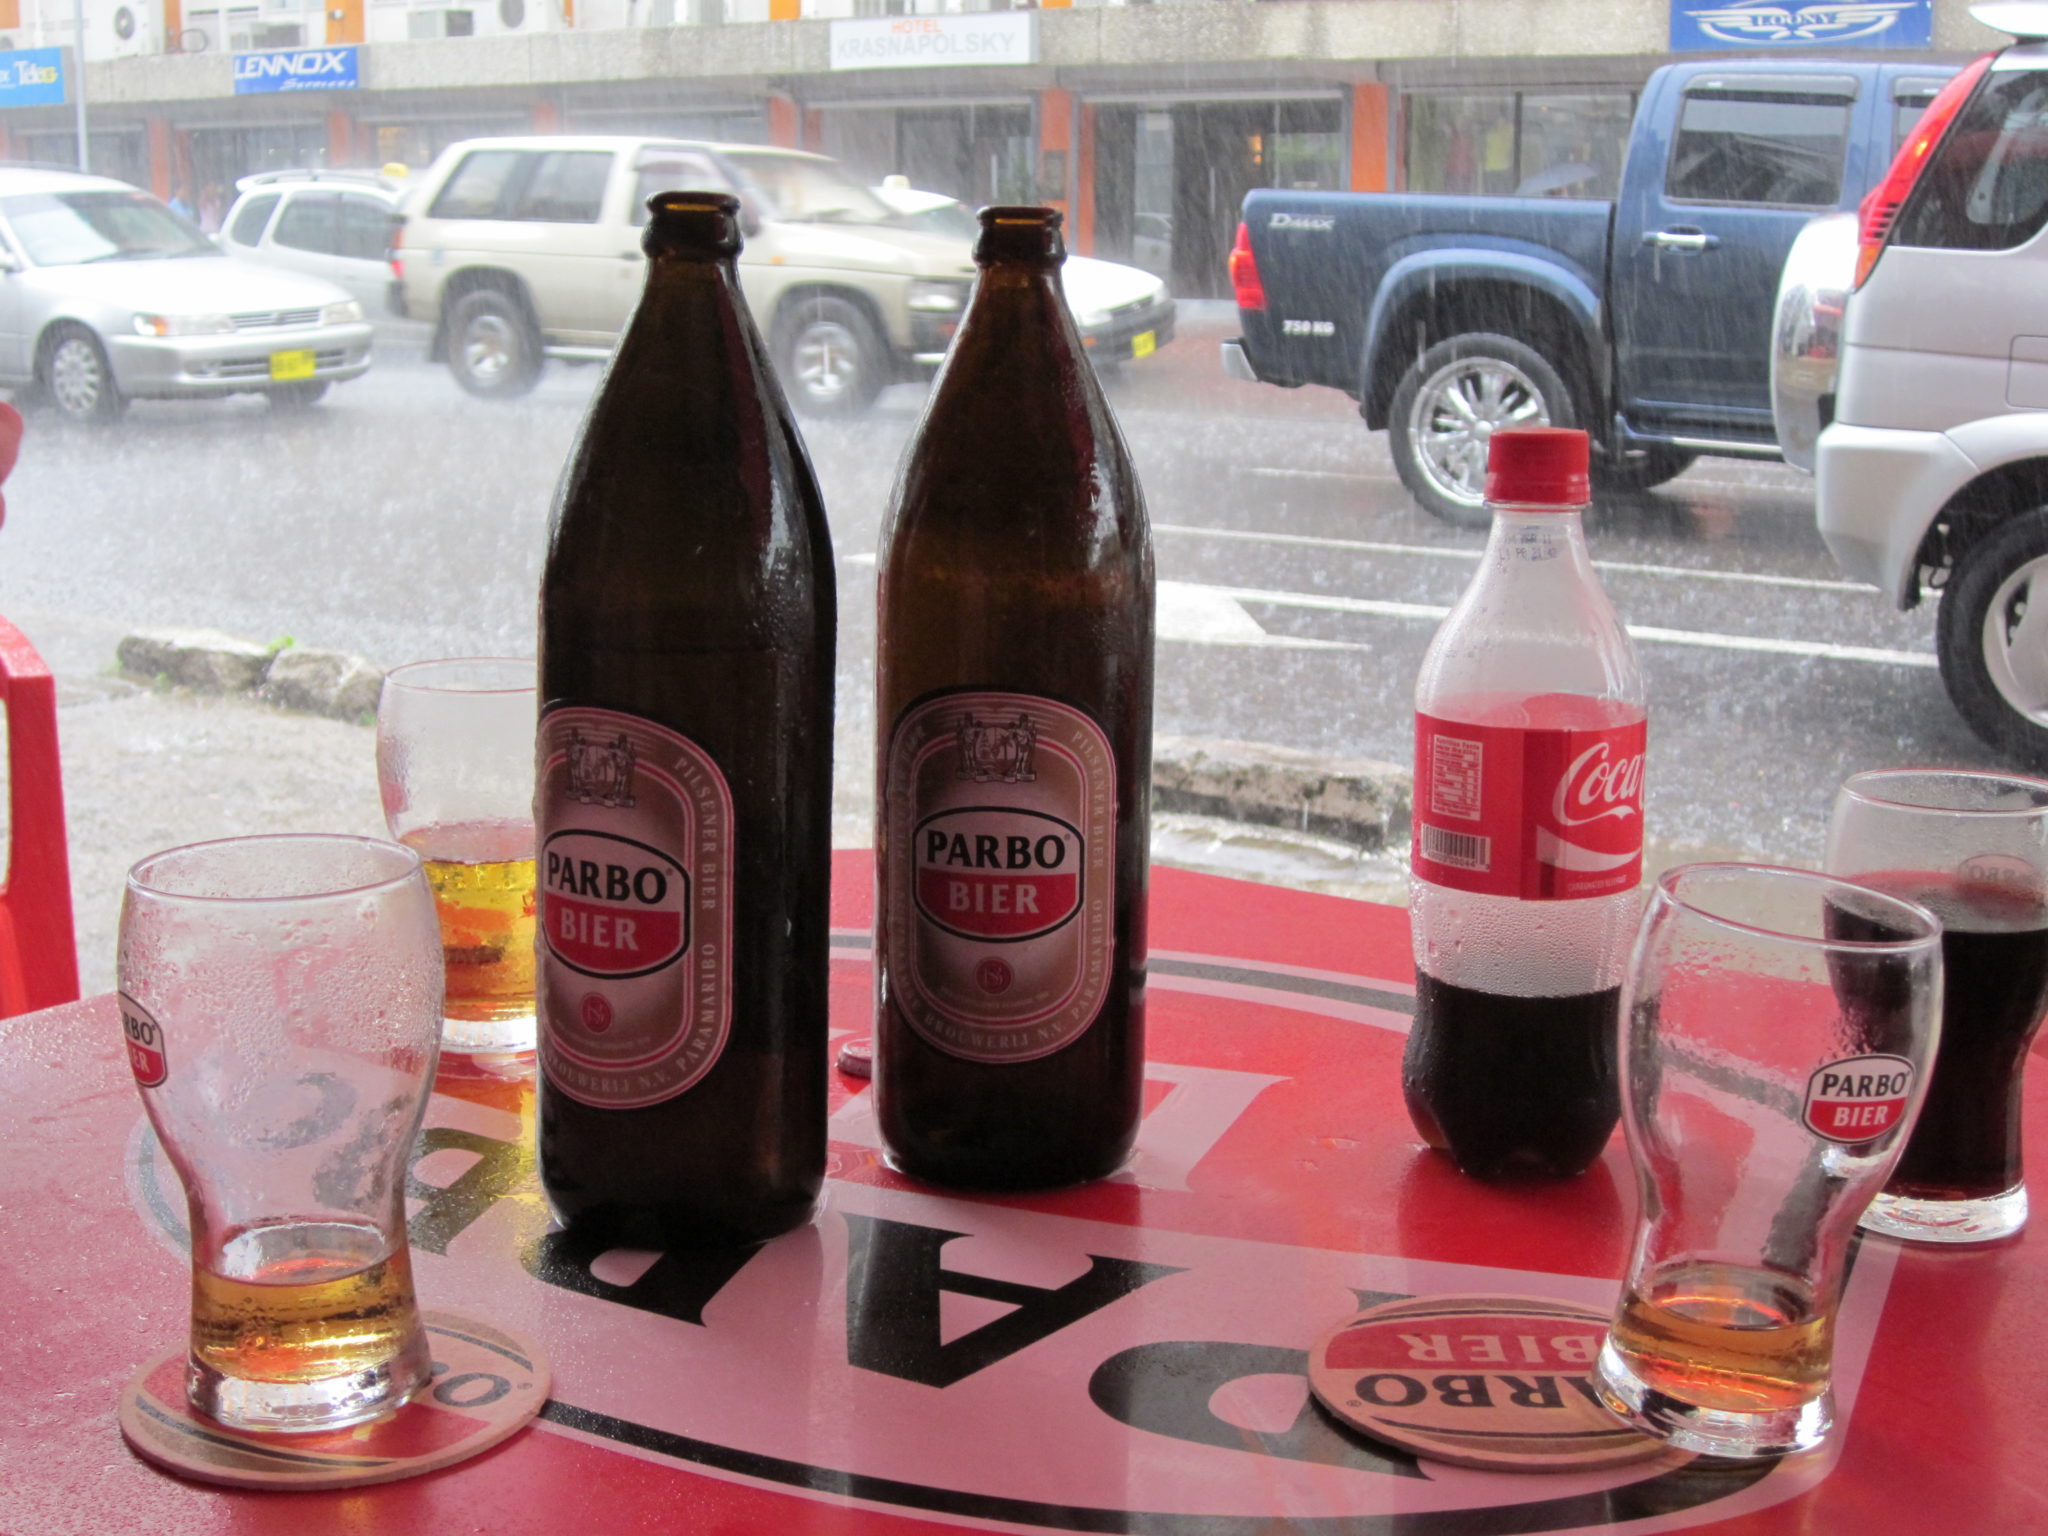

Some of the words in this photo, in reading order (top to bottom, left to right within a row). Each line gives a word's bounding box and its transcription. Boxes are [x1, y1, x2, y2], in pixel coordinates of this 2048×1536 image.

[891, 18, 943, 34] HOTEL
[836, 32, 1016, 58] KRASNAPOLSKY
[234, 50, 348, 79] LENNOX
[674, 756, 717, 853] PILSENER
[702, 863, 717, 910] BIER
[926, 829, 1066, 870] PARBO
[1093, 824, 1105, 868] BIER
[547, 851, 667, 905] PARBO
[949, 880, 1040, 915] BIER
[560, 907, 640, 951] BIER
[924, 1012, 1029, 1049] BROUWERIJ
[1071, 898, 1104, 1020] PARAMARIBO
[676, 943, 717, 1072] PARAMARIBO
[1819, 1072, 1907, 1098] PARBO
[1832, 1106, 1889, 1127] BIER
[1397, 1334, 1600, 1364] BIER
[1355, 1374, 1606, 1409] ARBO
